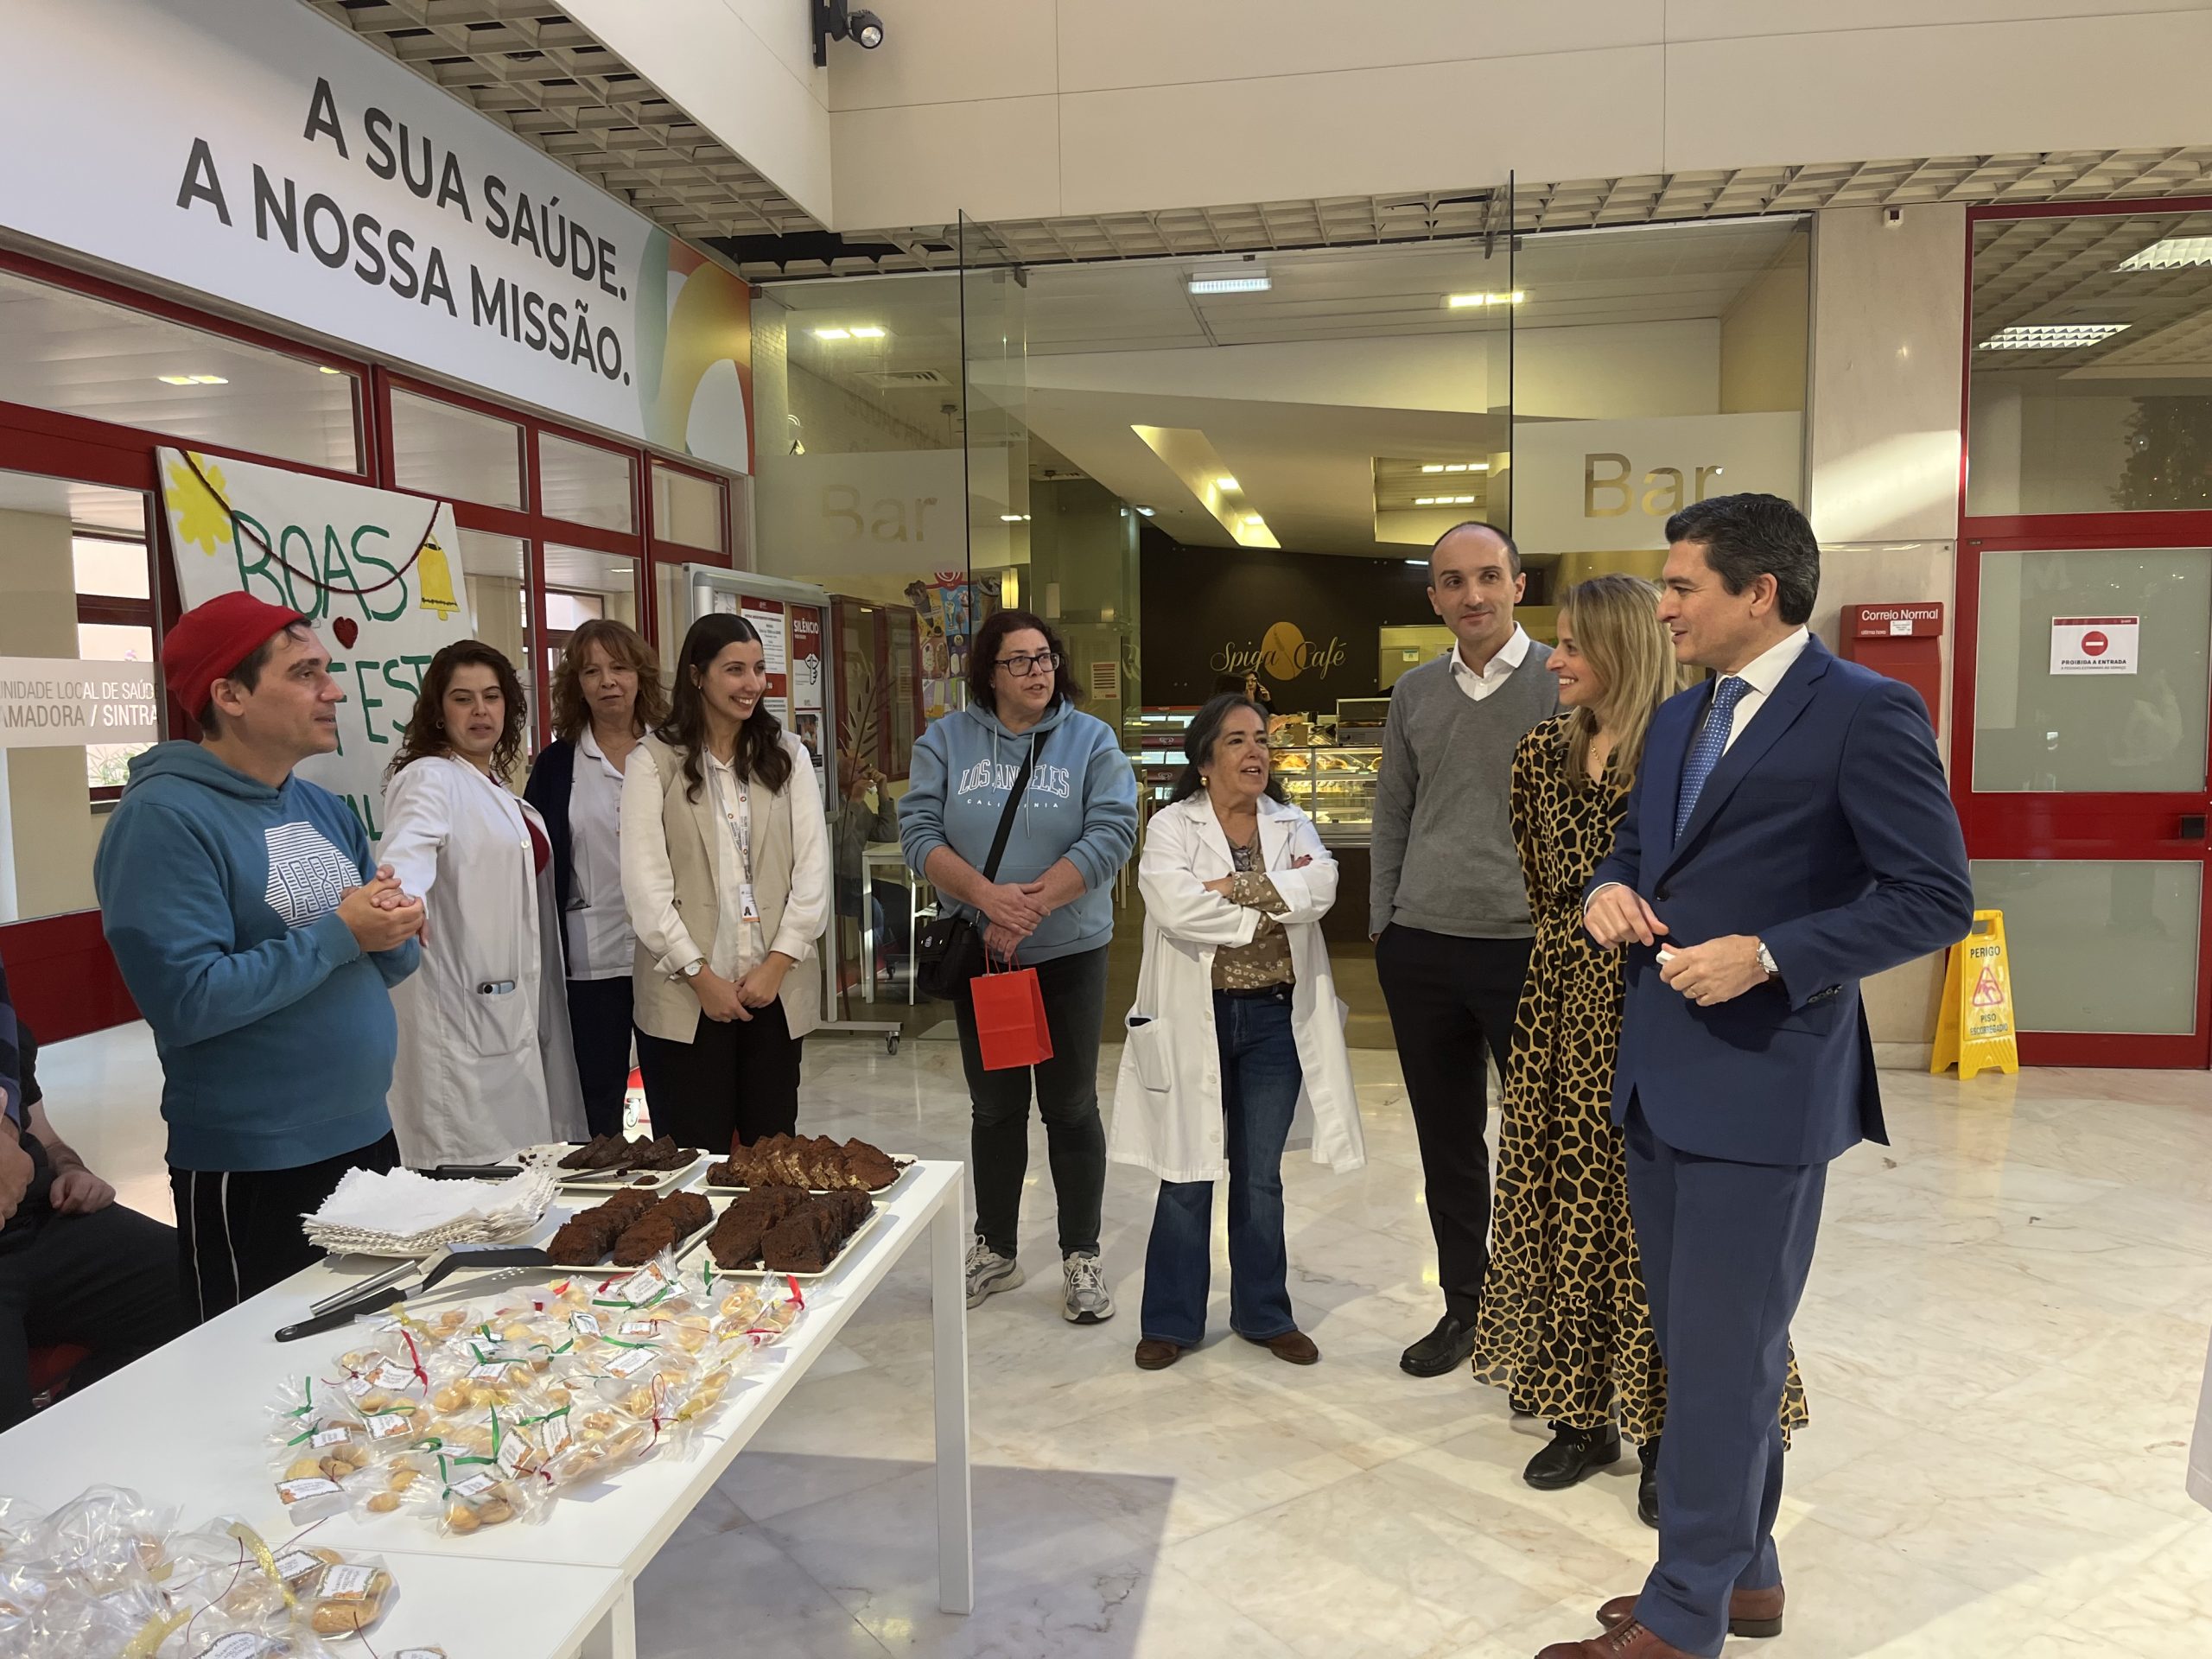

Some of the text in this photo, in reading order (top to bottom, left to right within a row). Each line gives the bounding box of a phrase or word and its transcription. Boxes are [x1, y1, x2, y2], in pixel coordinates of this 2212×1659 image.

[303, 76, 627, 302] A SUA SAÚDE.
[176, 137, 630, 386] A NOSSA MISSÃO.
[1584, 452, 1724, 518] Bar
[822, 484, 939, 543] Bar
[231, 510, 408, 621] BOAS
[793, 618, 819, 635] SILÊNCIO
[1861, 608, 1938, 620] Correio Normal
[1210, 636, 1347, 680] Spiga Café
[57, 681, 99, 700] LOCAL
[102, 682, 119, 700] DE
[103, 703, 159, 728] SINTRA
[958, 759, 1070, 798] LOS ANELES
[1970, 945, 2000, 958] PERIGO
[1980, 1013, 1996, 1024] PISO
